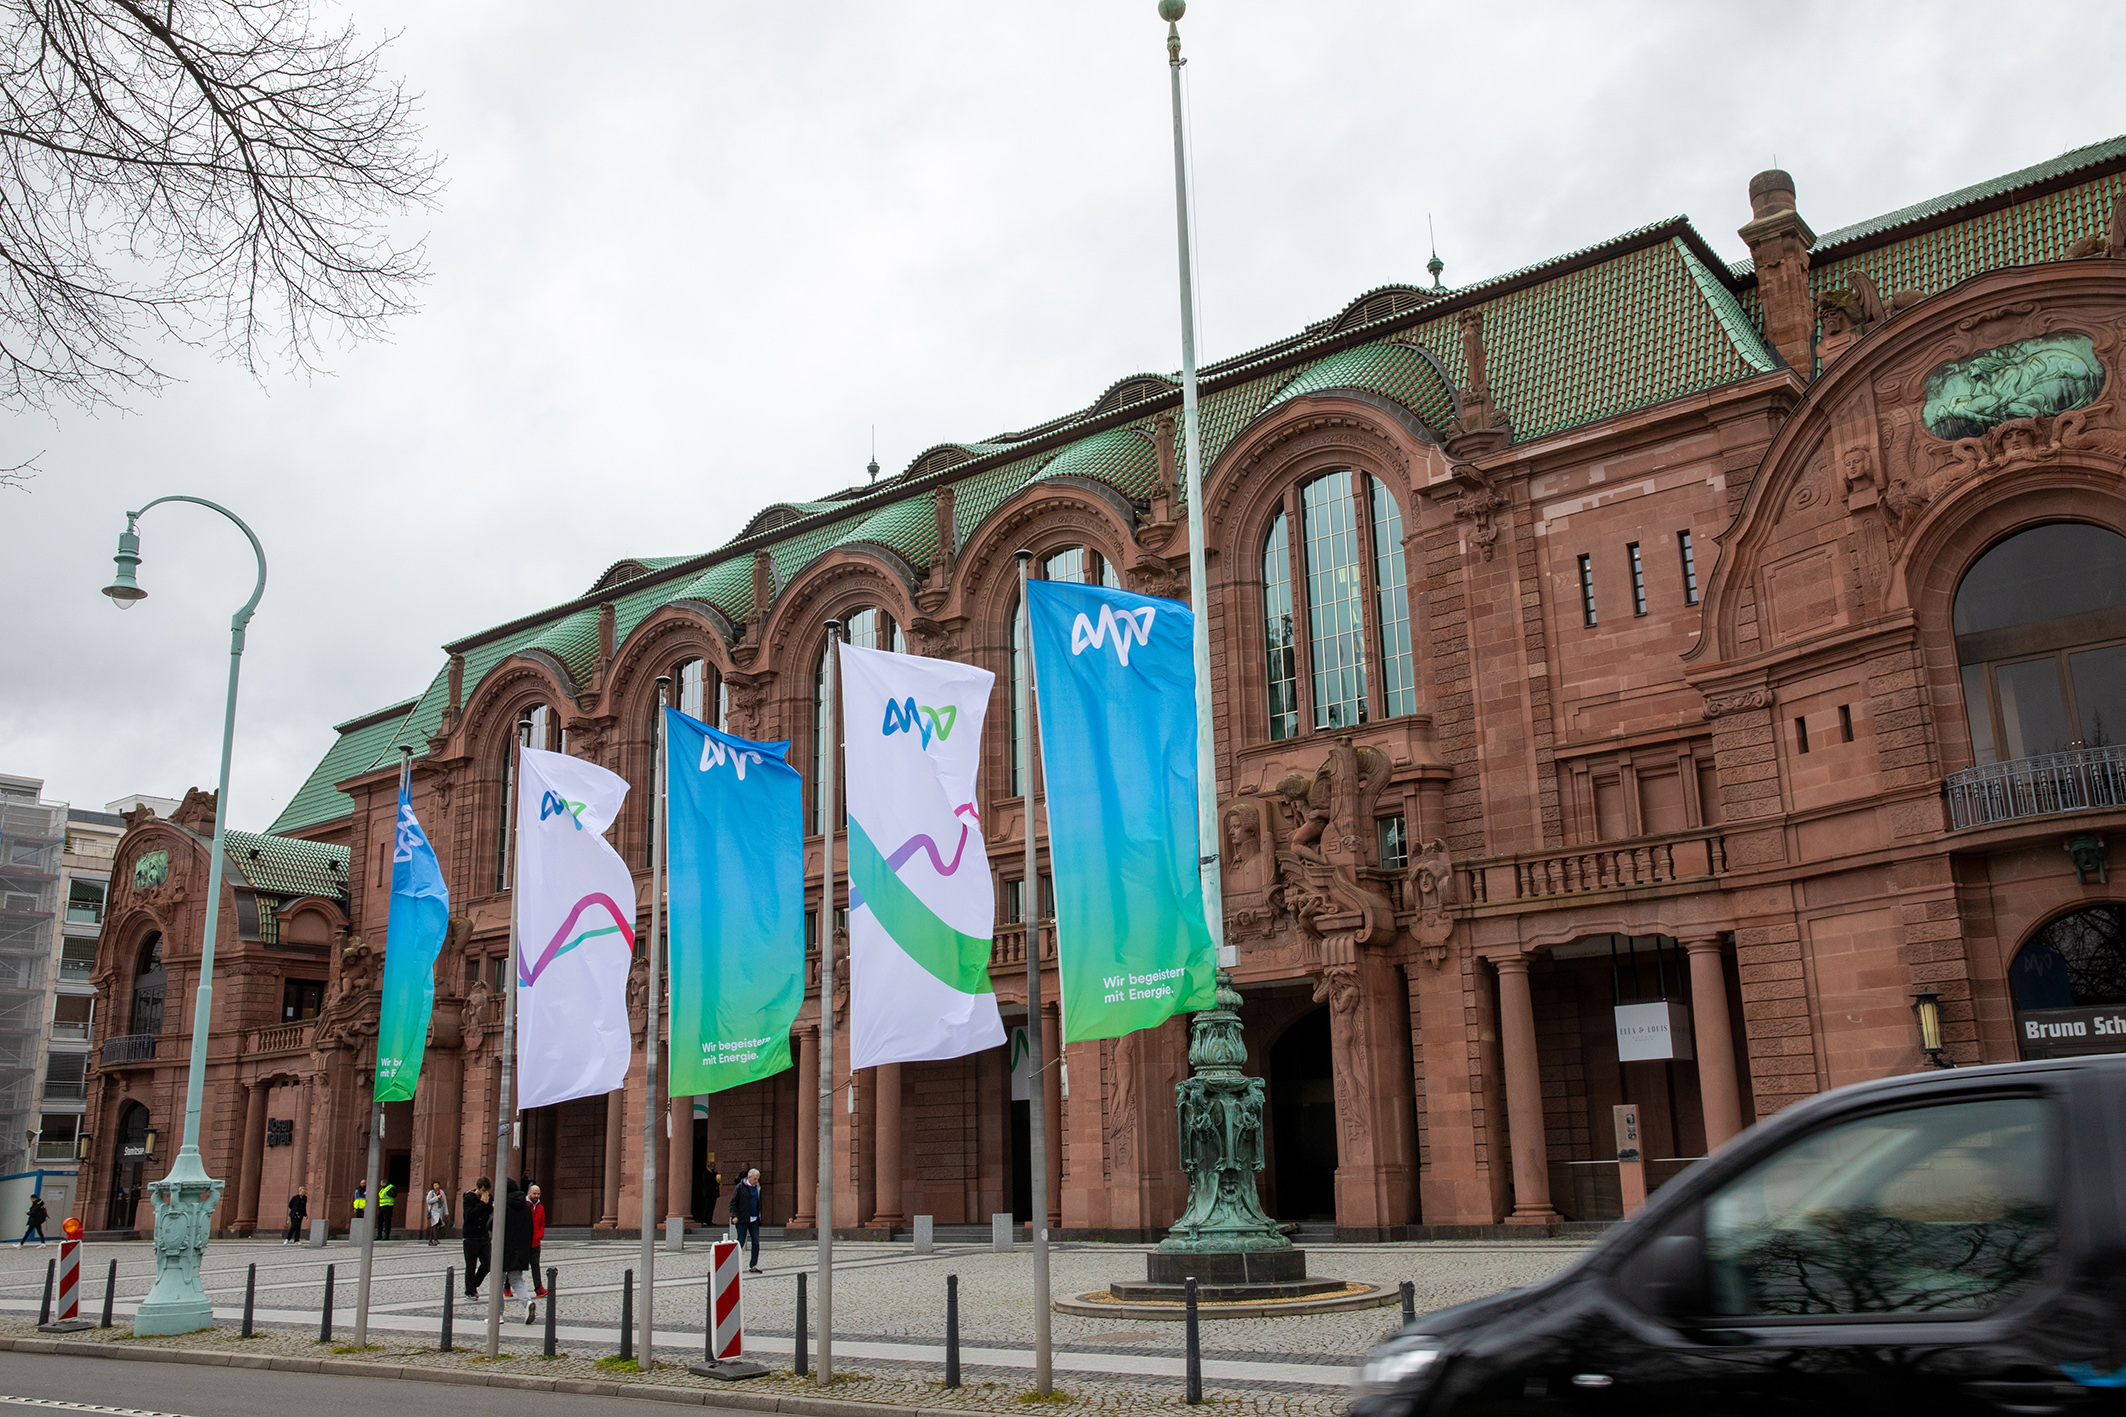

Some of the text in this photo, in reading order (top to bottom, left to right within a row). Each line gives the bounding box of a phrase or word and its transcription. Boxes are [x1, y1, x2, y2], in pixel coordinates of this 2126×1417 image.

[1103, 975, 1125, 989] Wir
[1104, 983, 1174, 1004] mit Energie.
[1620, 1027, 1636, 1035] ELLA
[1648, 1025, 1668, 1033] LOUIS
[2025, 1021, 2087, 1039] Bruno
[702, 1042, 716, 1053] Wir
[380, 1057, 391, 1067] Wir
[702, 1051, 759, 1066] mit Energie.
